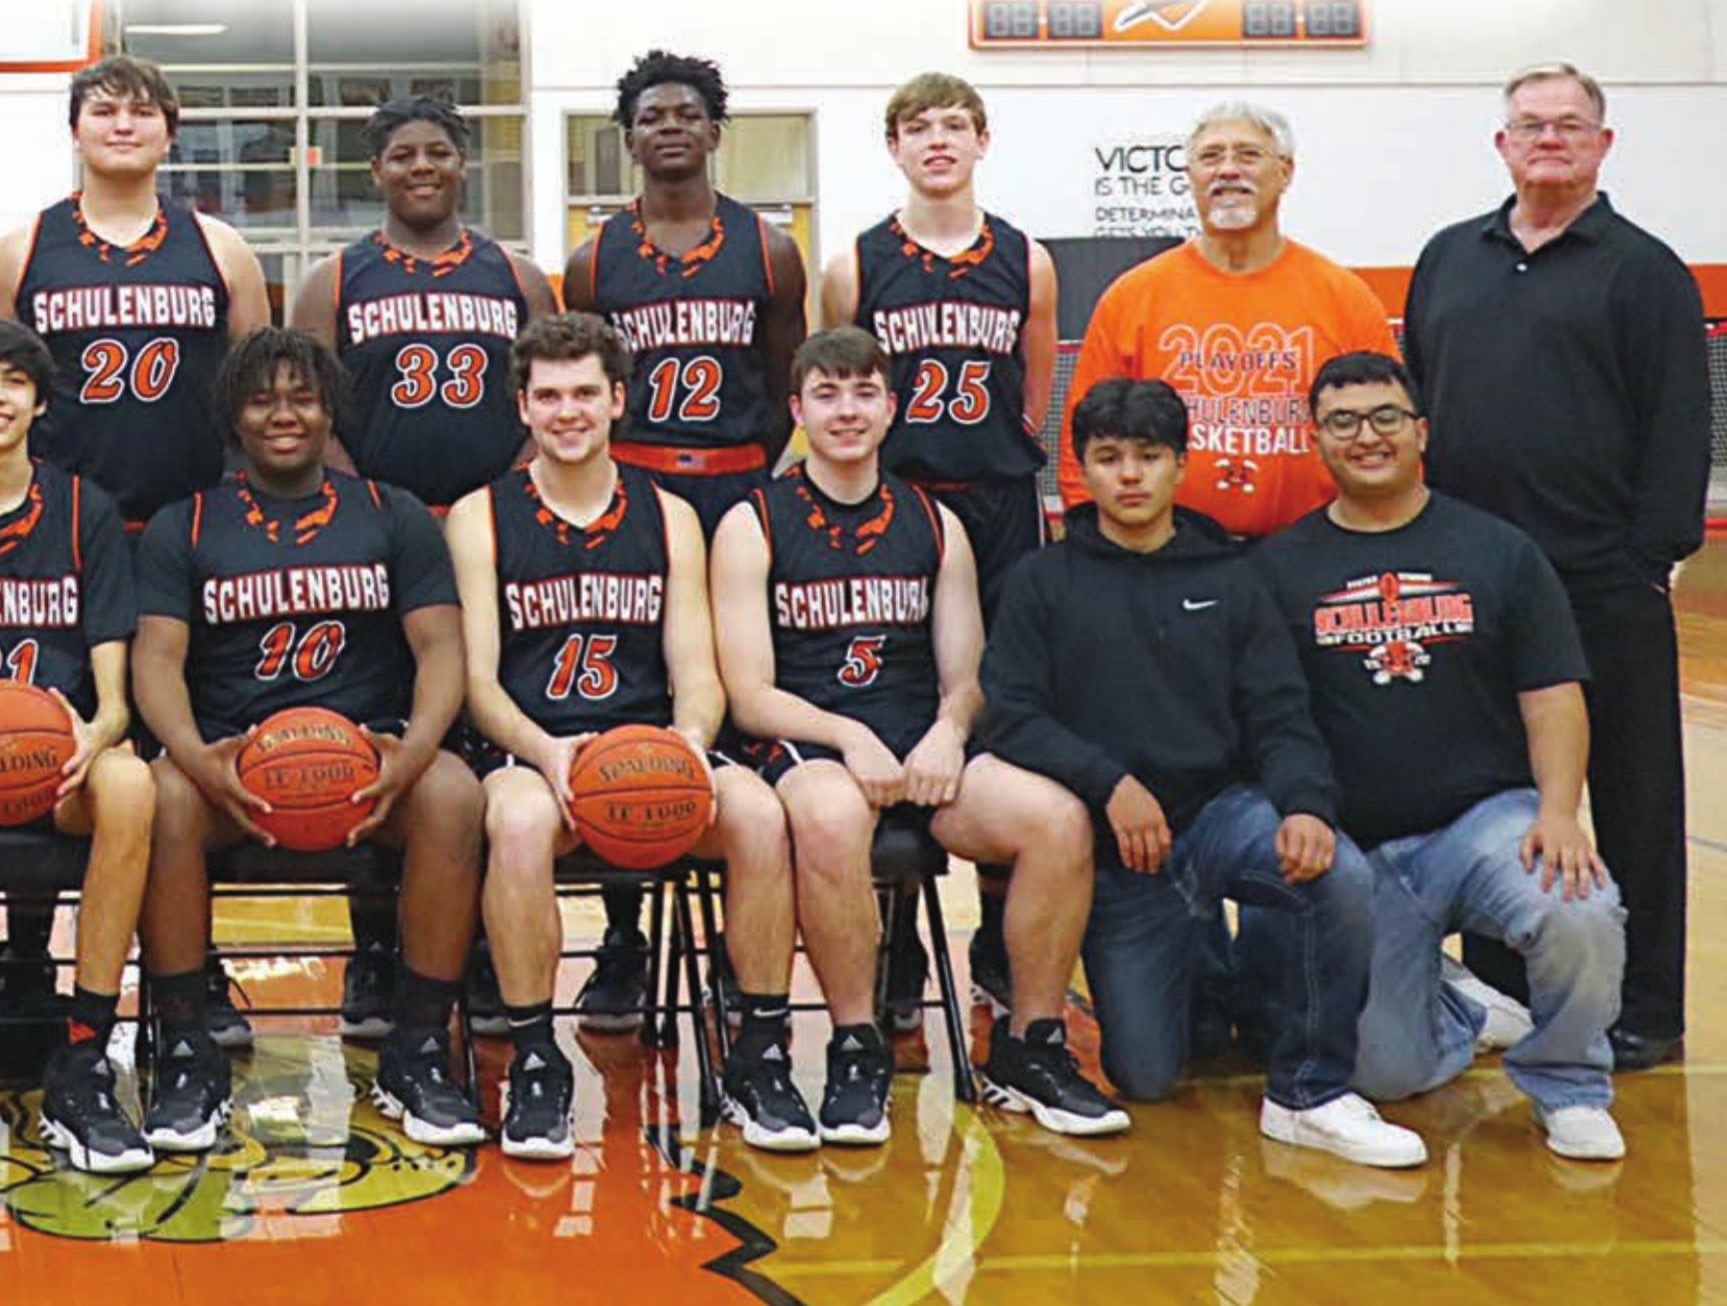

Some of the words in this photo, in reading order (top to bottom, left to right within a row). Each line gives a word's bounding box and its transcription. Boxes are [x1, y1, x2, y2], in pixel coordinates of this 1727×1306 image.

[1095, 145, 1190, 172] VICTO
[1095, 176, 1112, 196] IS
[1118, 176, 1163, 196] THE
[1095, 207, 1196, 222] DETERMINA
[33, 285, 216, 334] SCHULENBURG
[347, 292, 518, 345] SCHULENBURG
[611, 300, 756, 351] SCHULENBURG
[874, 302, 1020, 354] SCHULENBURG
[80, 338, 180, 403] 20
[391, 343, 489, 408] 33
[1159, 322, 1314, 397] 2021
[1180, 351, 1296, 371] PLAYOFFS
[648, 355, 723, 422] 12
[905, 358, 991, 424] 25
[1188, 424, 1310, 454] SKETBALL
[203, 563, 390, 624] SCHULENBURG
[505, 574, 663, 630] SCHULENBURG
[254, 619, 346, 682] 10
[1335, 621, 1458, 645] FOOTBALL
[545, 632, 619, 699] 15
[836, 634, 887, 687] 5
[598, 756, 695, 782] SPALDING
[645, 801, 697, 821] 1000
